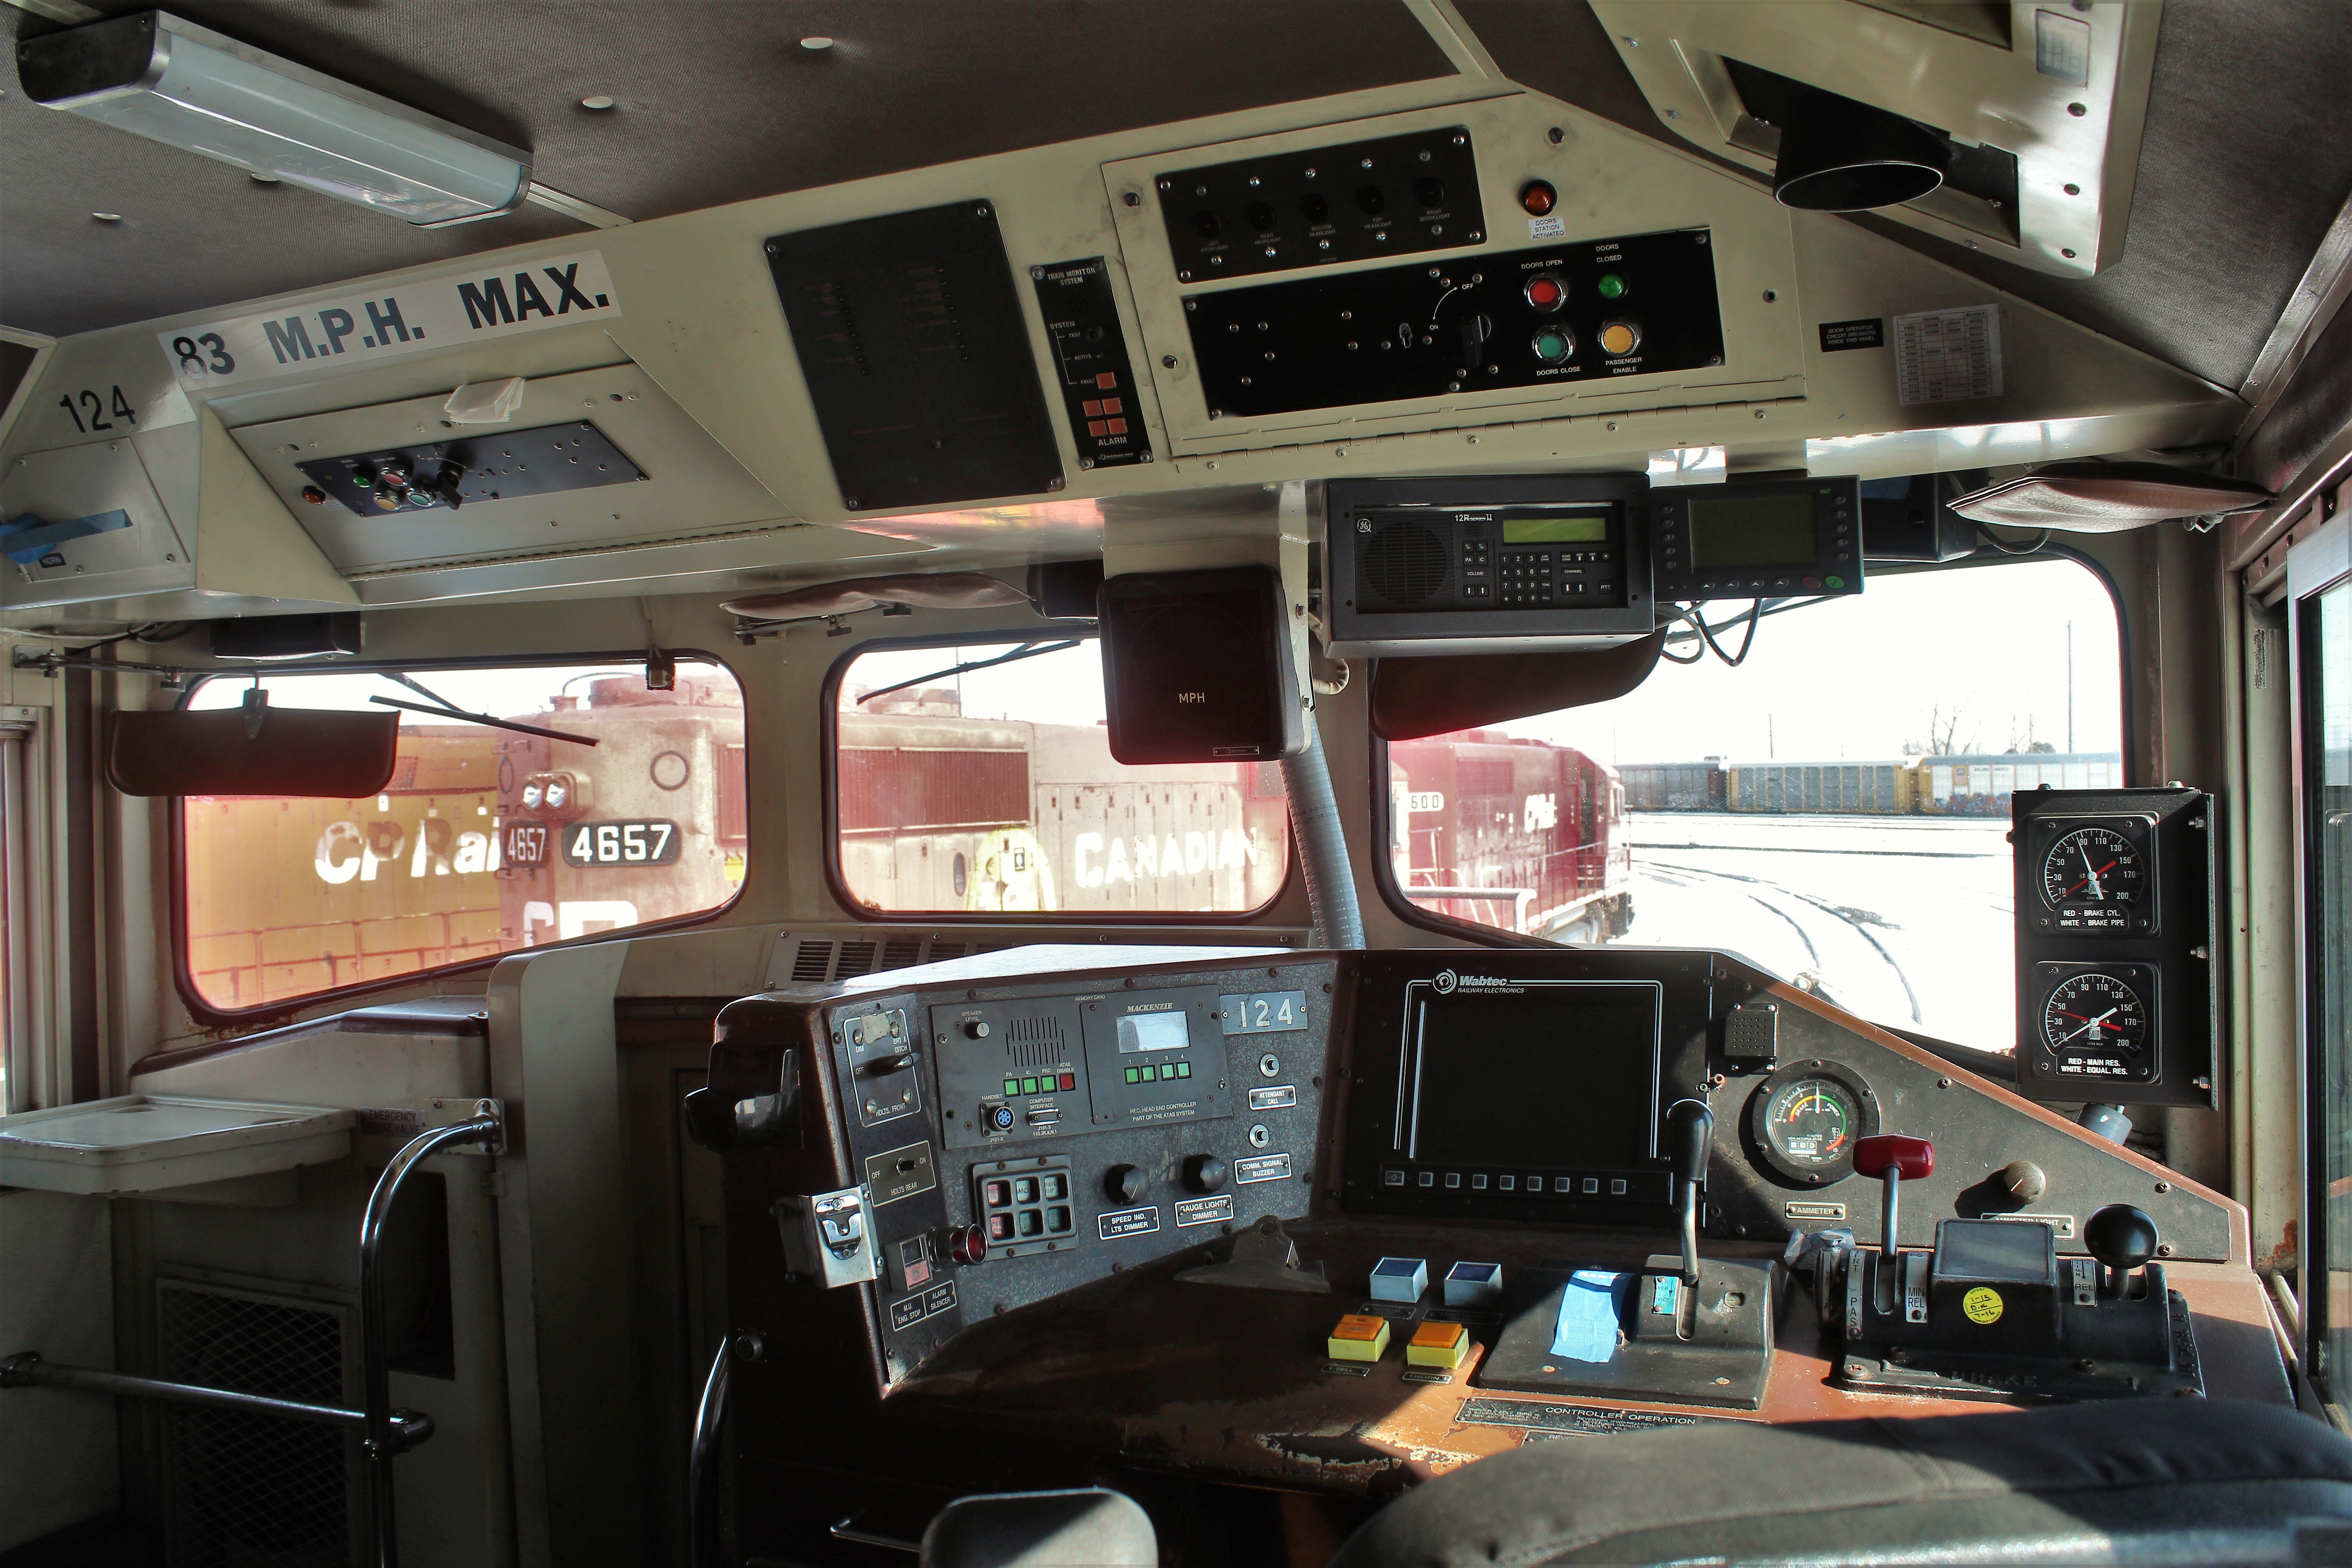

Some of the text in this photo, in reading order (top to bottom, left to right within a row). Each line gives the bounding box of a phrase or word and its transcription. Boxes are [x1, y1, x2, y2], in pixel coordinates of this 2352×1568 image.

[1365, 221, 1392, 229] HEADLIGHT
[1534, 225, 1559, 233] STATION
[1308, 229, 1336, 237] HEADLIGHT
[1533, 230, 1564, 240] ACTIVATED
[1596, 255, 1622, 263] CLOSED
[1047, 267, 1095, 280] TRAIN MONITOR
[1060, 277, 1083, 286] SYSTEM
[172, 263, 610, 380] 83 M.P.H. MAX.
[1050, 321, 1075, 329] SYSTEM
[1605, 358, 1642, 366] PASSENGER
[60, 385, 136, 433] 124
[1098, 437, 1127, 446] ALARM
[1179, 692, 1205, 703] MPH
[507, 827, 545, 861] 4657
[572, 824, 671, 861] 4657
[315, 820, 406, 884] CP
[1075, 827, 1258, 888] CANADIAN
[1460, 975, 1507, 986] Wabtec
[1127, 1002, 1173, 1013] MACKENZIE
[1240, 999, 1293, 1028] 124
[895, 1045, 907, 1054] DITCH
[1259, 1090, 1285, 1098] ATTENDANT
[876, 1103, 906, 1117] HDLTS. FRONT
[1166, 1102, 1197, 1110] CONTROLLER
[1827, 1102, 1840, 1117] POWER
[1242, 1159, 1283, 1170] COMM. SIGNAL
[1252, 1169, 1275, 1177] BUZZER
[891, 1182, 917, 1196] HDLTS REAR
[1180, 1199, 1227, 1212] GAUGE LIGHTS
[1797, 1206, 1834, 1216] AMMETER
[1111, 1213, 1146, 1225] SPEED IND.
[1192, 1210, 1218, 1220] DIMMER
[1111, 1221, 1148, 1233] LTS DIMMER
[932, 1289, 946, 1299] ALARM
[1908, 1287, 1924, 1297] MIN
[904, 1303, 913, 1312] M.U.
[931, 1297, 951, 1310] SILENCER
[1908, 1298, 1925, 1308] REL
[898, 1310, 921, 1324] ENG. STOP
[1546, 1406, 1623, 1419] CONTROLLER
[1628, 1414, 1695, 1425] OPERATION
